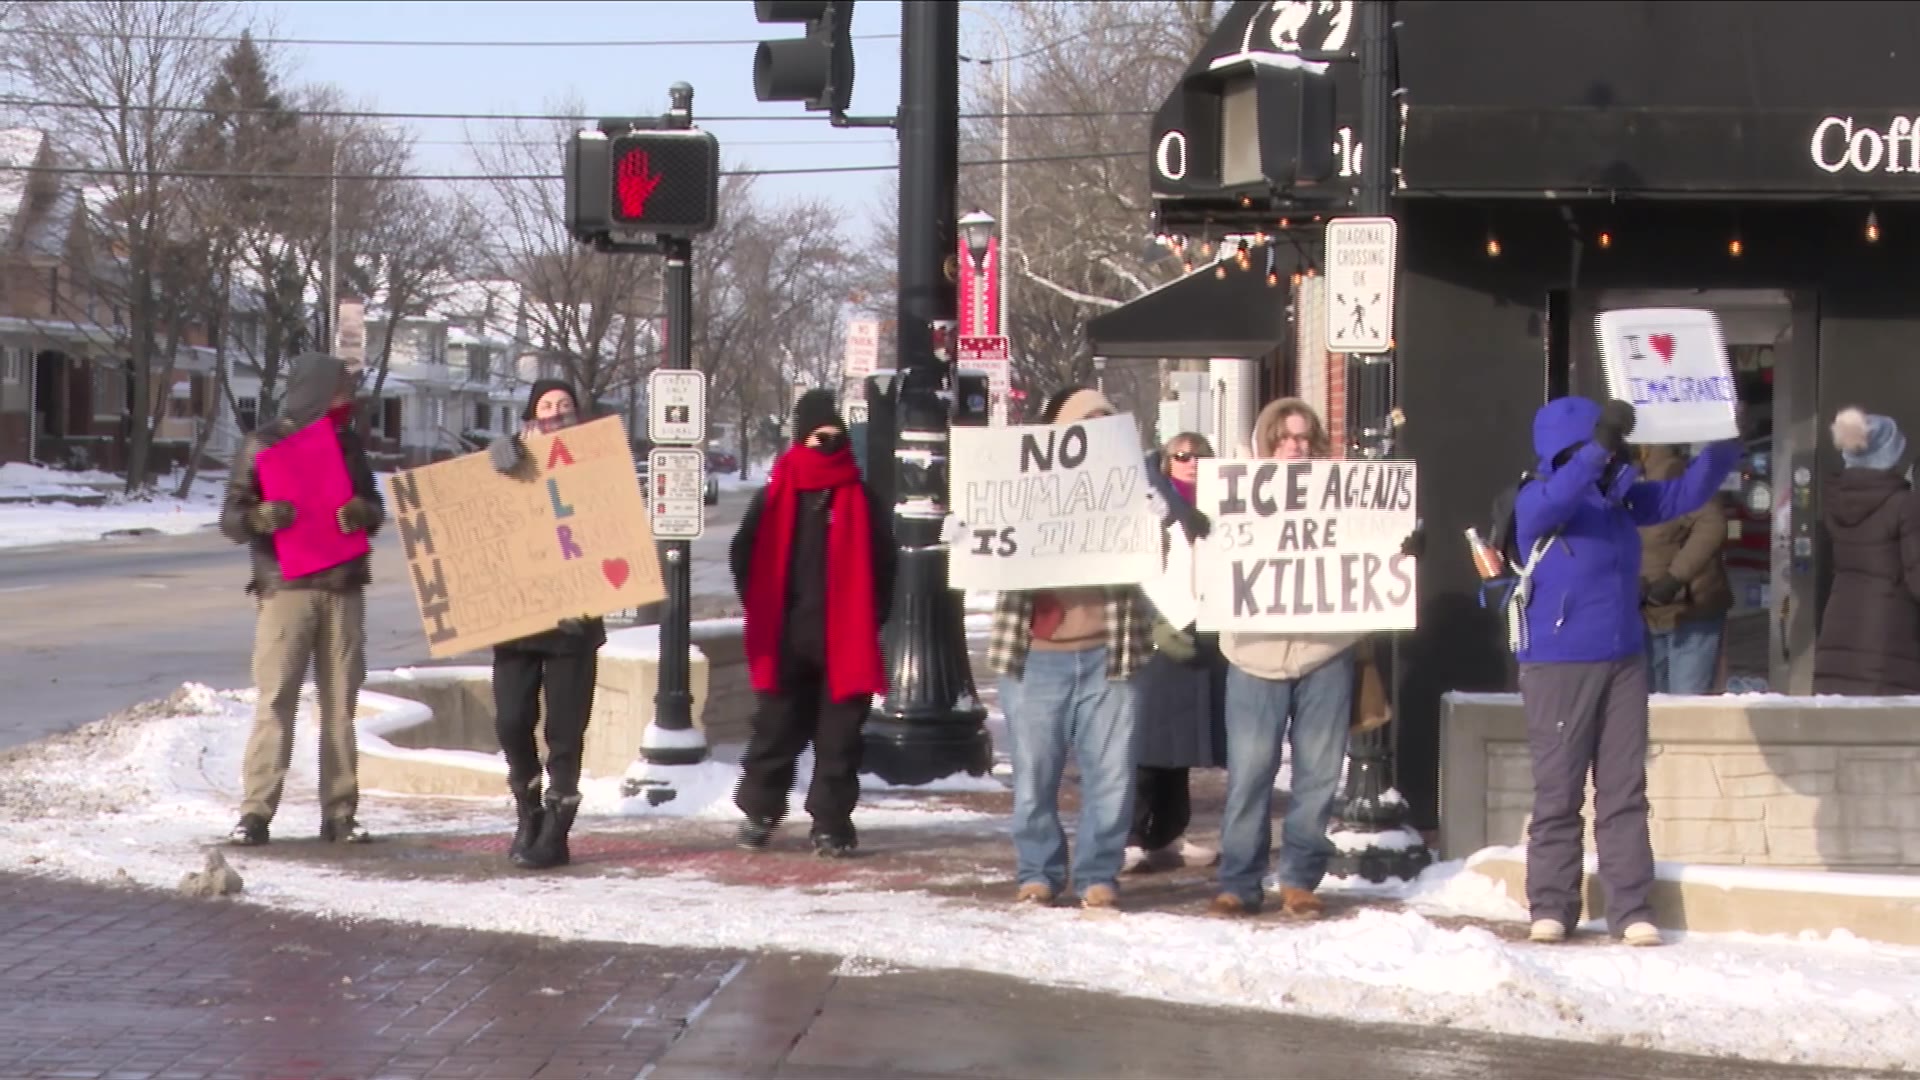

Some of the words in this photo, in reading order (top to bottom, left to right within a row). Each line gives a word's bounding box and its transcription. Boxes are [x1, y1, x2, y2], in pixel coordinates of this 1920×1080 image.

[1336, 227, 1385, 245] DIAGONAL
[1337, 249, 1384, 266] CROSSING
[1622, 334, 1648, 361] I
[1020, 424, 1088, 473] NO
[966, 465, 1138, 526] HUMAN
[1218, 462, 1312, 517] ICE
[1320, 463, 1413, 511] AGENTS
[971, 526, 1017, 557] IS
[1031, 514, 1159, 558] ILLEGAL
[1278, 518, 1337, 552] ARE
[1232, 552, 1412, 618] KILLERS
